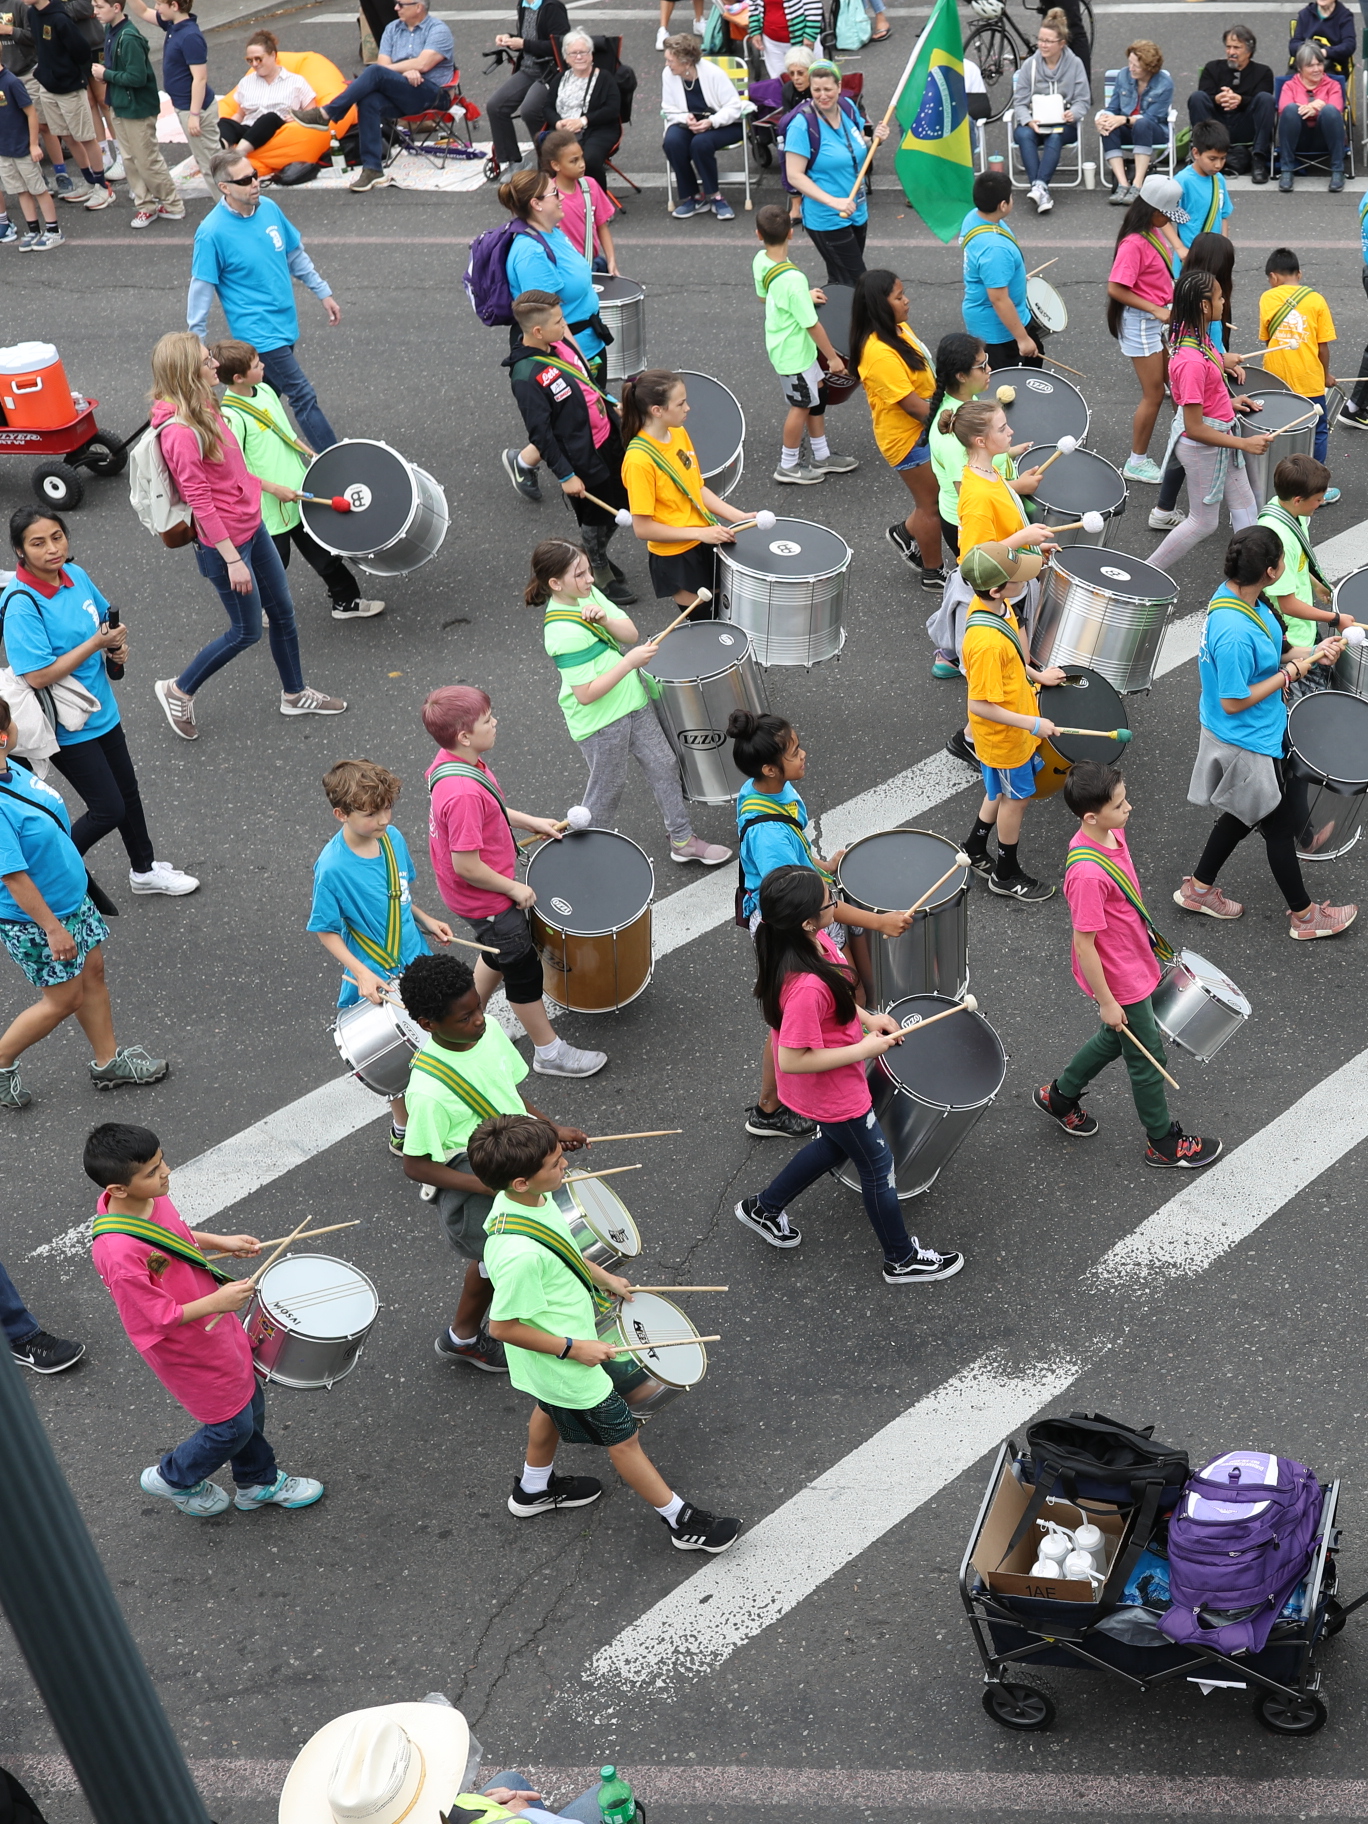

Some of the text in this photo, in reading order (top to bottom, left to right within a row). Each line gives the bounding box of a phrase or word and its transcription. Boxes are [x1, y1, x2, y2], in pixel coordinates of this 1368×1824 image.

[1027, 380, 1053, 393] IZZO
[683, 733, 721, 746] IZZO
[553, 899, 571, 913] IZZO
[903, 1014, 921, 1028] IZZO
